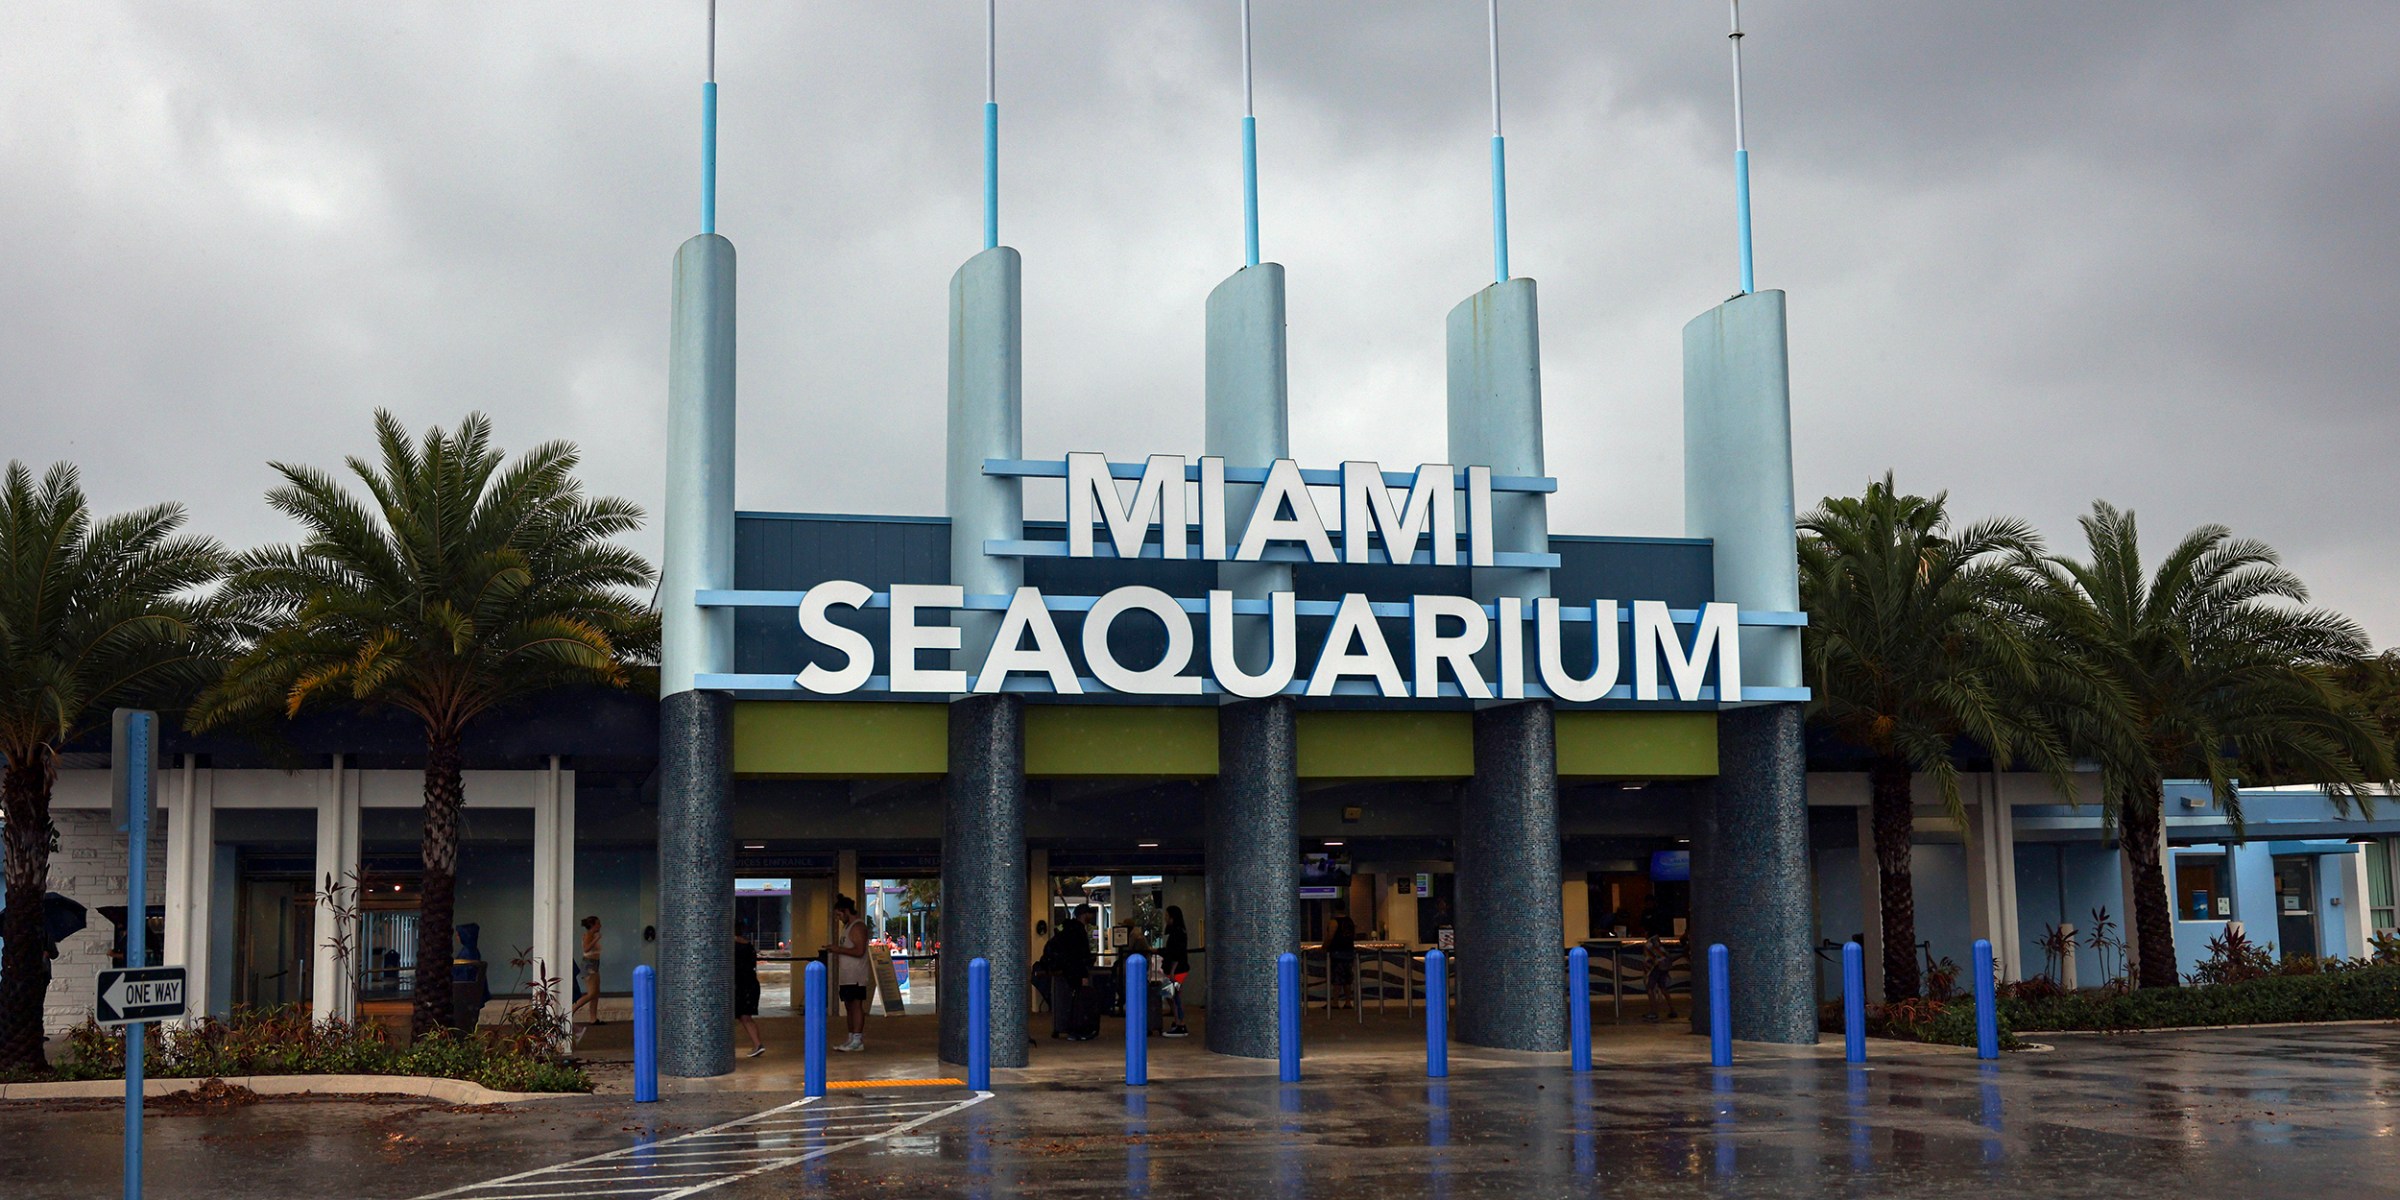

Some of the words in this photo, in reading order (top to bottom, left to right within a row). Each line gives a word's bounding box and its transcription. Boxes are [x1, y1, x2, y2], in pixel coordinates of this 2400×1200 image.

[1067, 452, 1494, 567] MIAMI
[796, 581, 1741, 703] SEAQUARIUM
[126, 984, 151, 1005] ONE
[155, 982, 179, 1003] WAY
